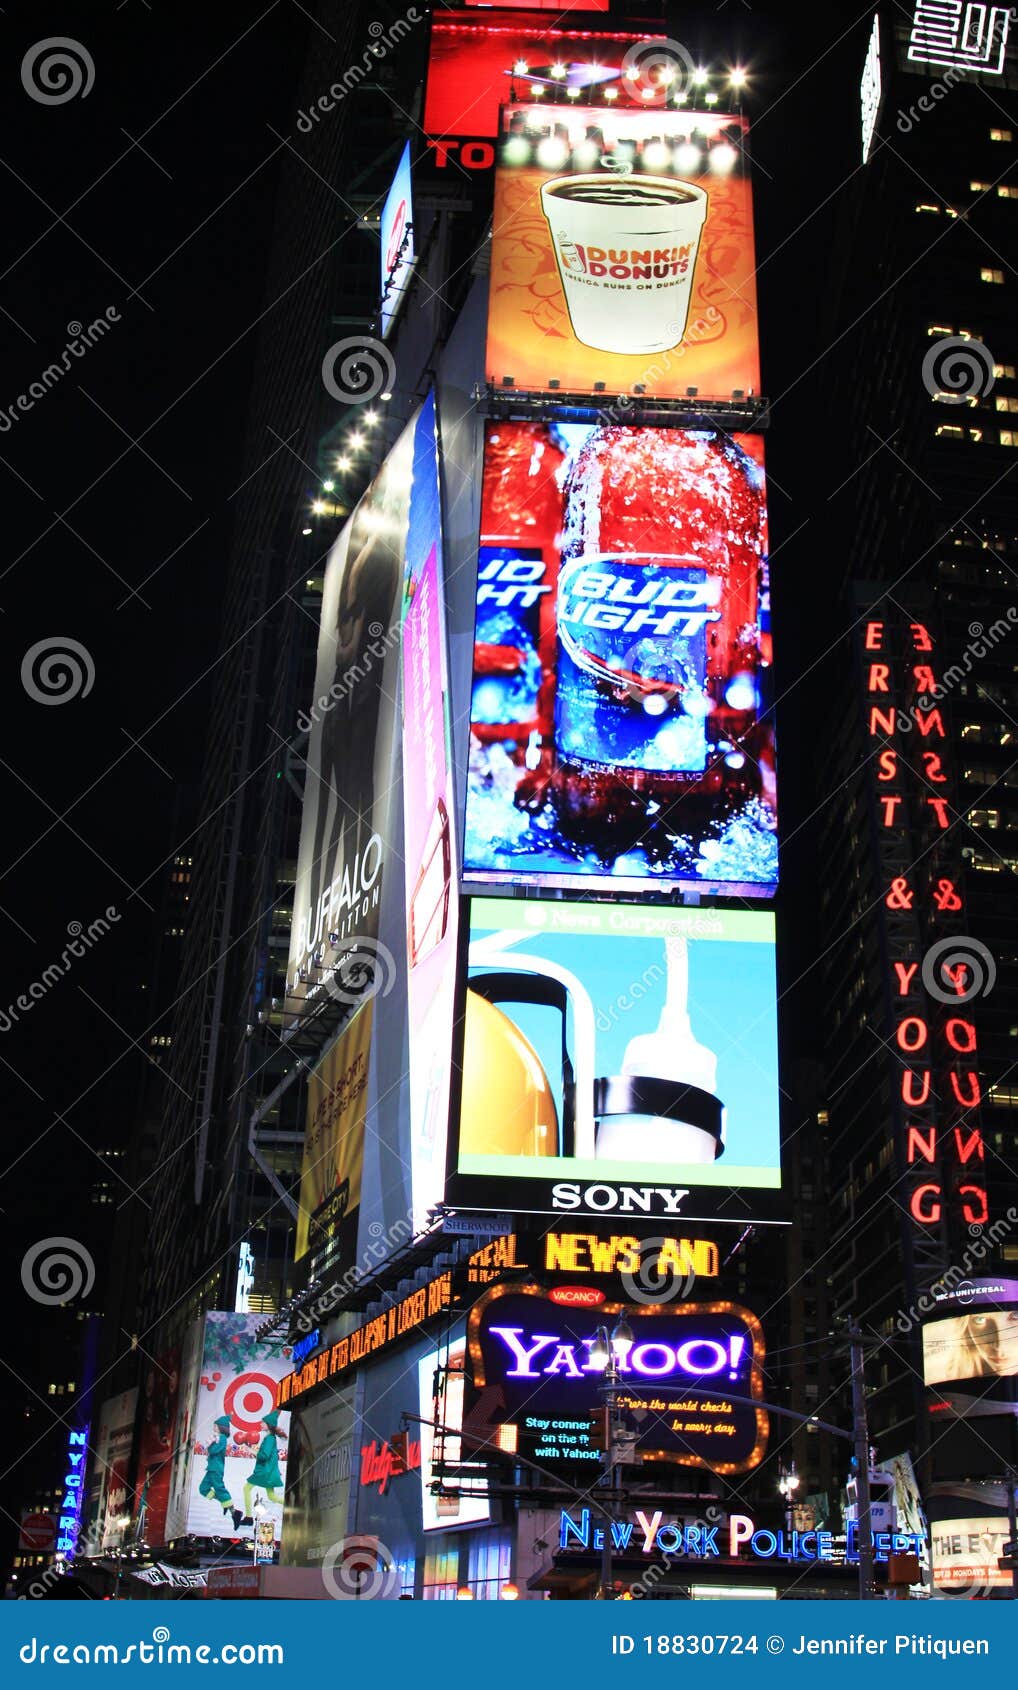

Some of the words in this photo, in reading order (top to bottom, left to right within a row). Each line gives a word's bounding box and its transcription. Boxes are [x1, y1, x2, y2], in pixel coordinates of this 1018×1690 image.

[586, 241, 695, 264] DUNKIN'
[589, 258, 688, 279] DONUTS
[603, 282, 631, 290] RUNS
[571, 572, 708, 607] BUD
[558, 600, 721, 636] LIGHT
[865, 622, 901, 828] ERNST
[296, 833, 382, 967] BUFFALO
[886, 877, 914, 910] &
[552, 911, 600, 928] News
[894, 962, 942, 1224] YOUNG
[552, 1183, 690, 1213] SONY
[445, 1219, 510, 1231] SHERWOOD
[545, 1232, 641, 1274] NEWS
[657, 1238, 719, 1277] AND
[552, 1291, 600, 1303] VACANCY
[955, 1286, 1006, 1297] UNIVERSAL
[700, 1401, 733, 1413] checks
[525, 1417, 551, 1430] Stay
[541, 1435, 556, 1443] on
[558, 1434, 577, 1444] the
[535, 1447, 560, 1458] with
[562, 1448, 601, 1460] Yahoo!
[635, 1511, 719, 1557] YORK
[729, 1514, 832, 1561] POLICE
[933, 1535, 962, 1556] THE
